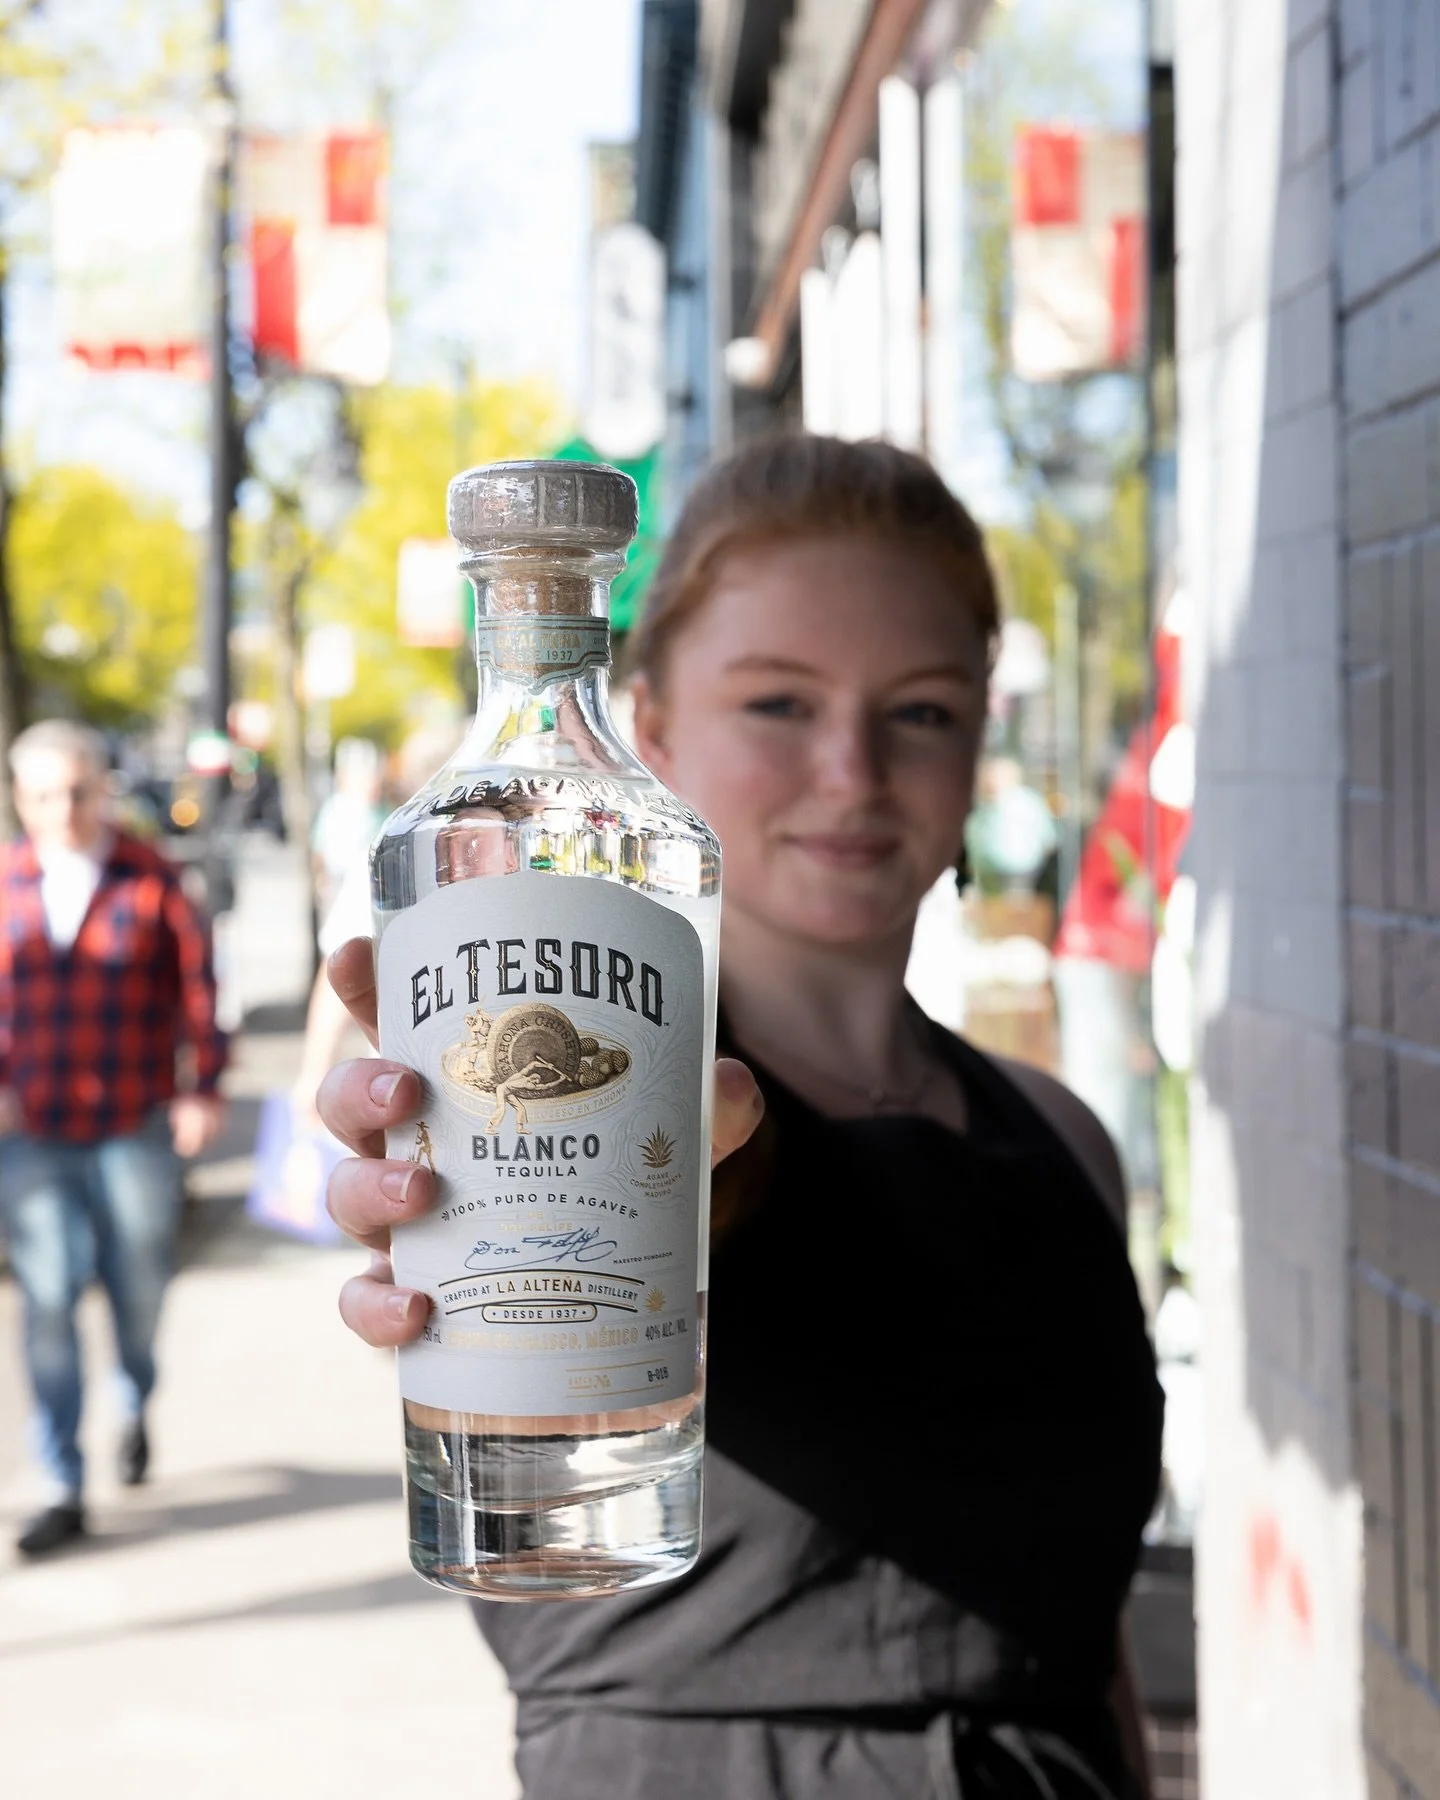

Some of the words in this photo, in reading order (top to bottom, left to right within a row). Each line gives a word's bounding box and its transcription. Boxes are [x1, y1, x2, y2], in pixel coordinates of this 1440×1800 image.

[546, 650, 572, 660] 1937
[411, 965, 453, 1030] EL
[456, 938, 664, 1026] TESORO
[499, 1017, 531, 1077] TAHONA
[534, 1015, 576, 1073] CRUSHED
[471, 1133, 600, 1161] BLANCO
[495, 1165, 578, 1177] TEQUILA
[452, 1198, 487, 1217] 100%
[494, 1193, 538, 1206] PURO
[547, 1193, 568, 1203] DE
[576, 1195, 628, 1216] AGAVE
[443, 1288, 478, 1304] CRAFTED
[481, 1285, 490, 1296] AT
[497, 1281, 516, 1294] LA
[523, 1276, 583, 1293] ALTEÑA
[588, 1284, 638, 1301] DISTILLERY
[504, 1310, 543, 1319] DESDE
[550, 1309, 577, 1319] 1937
[586, 1325, 639, 1349] MÉXICO
[645, 1324, 661, 1341] 40%
